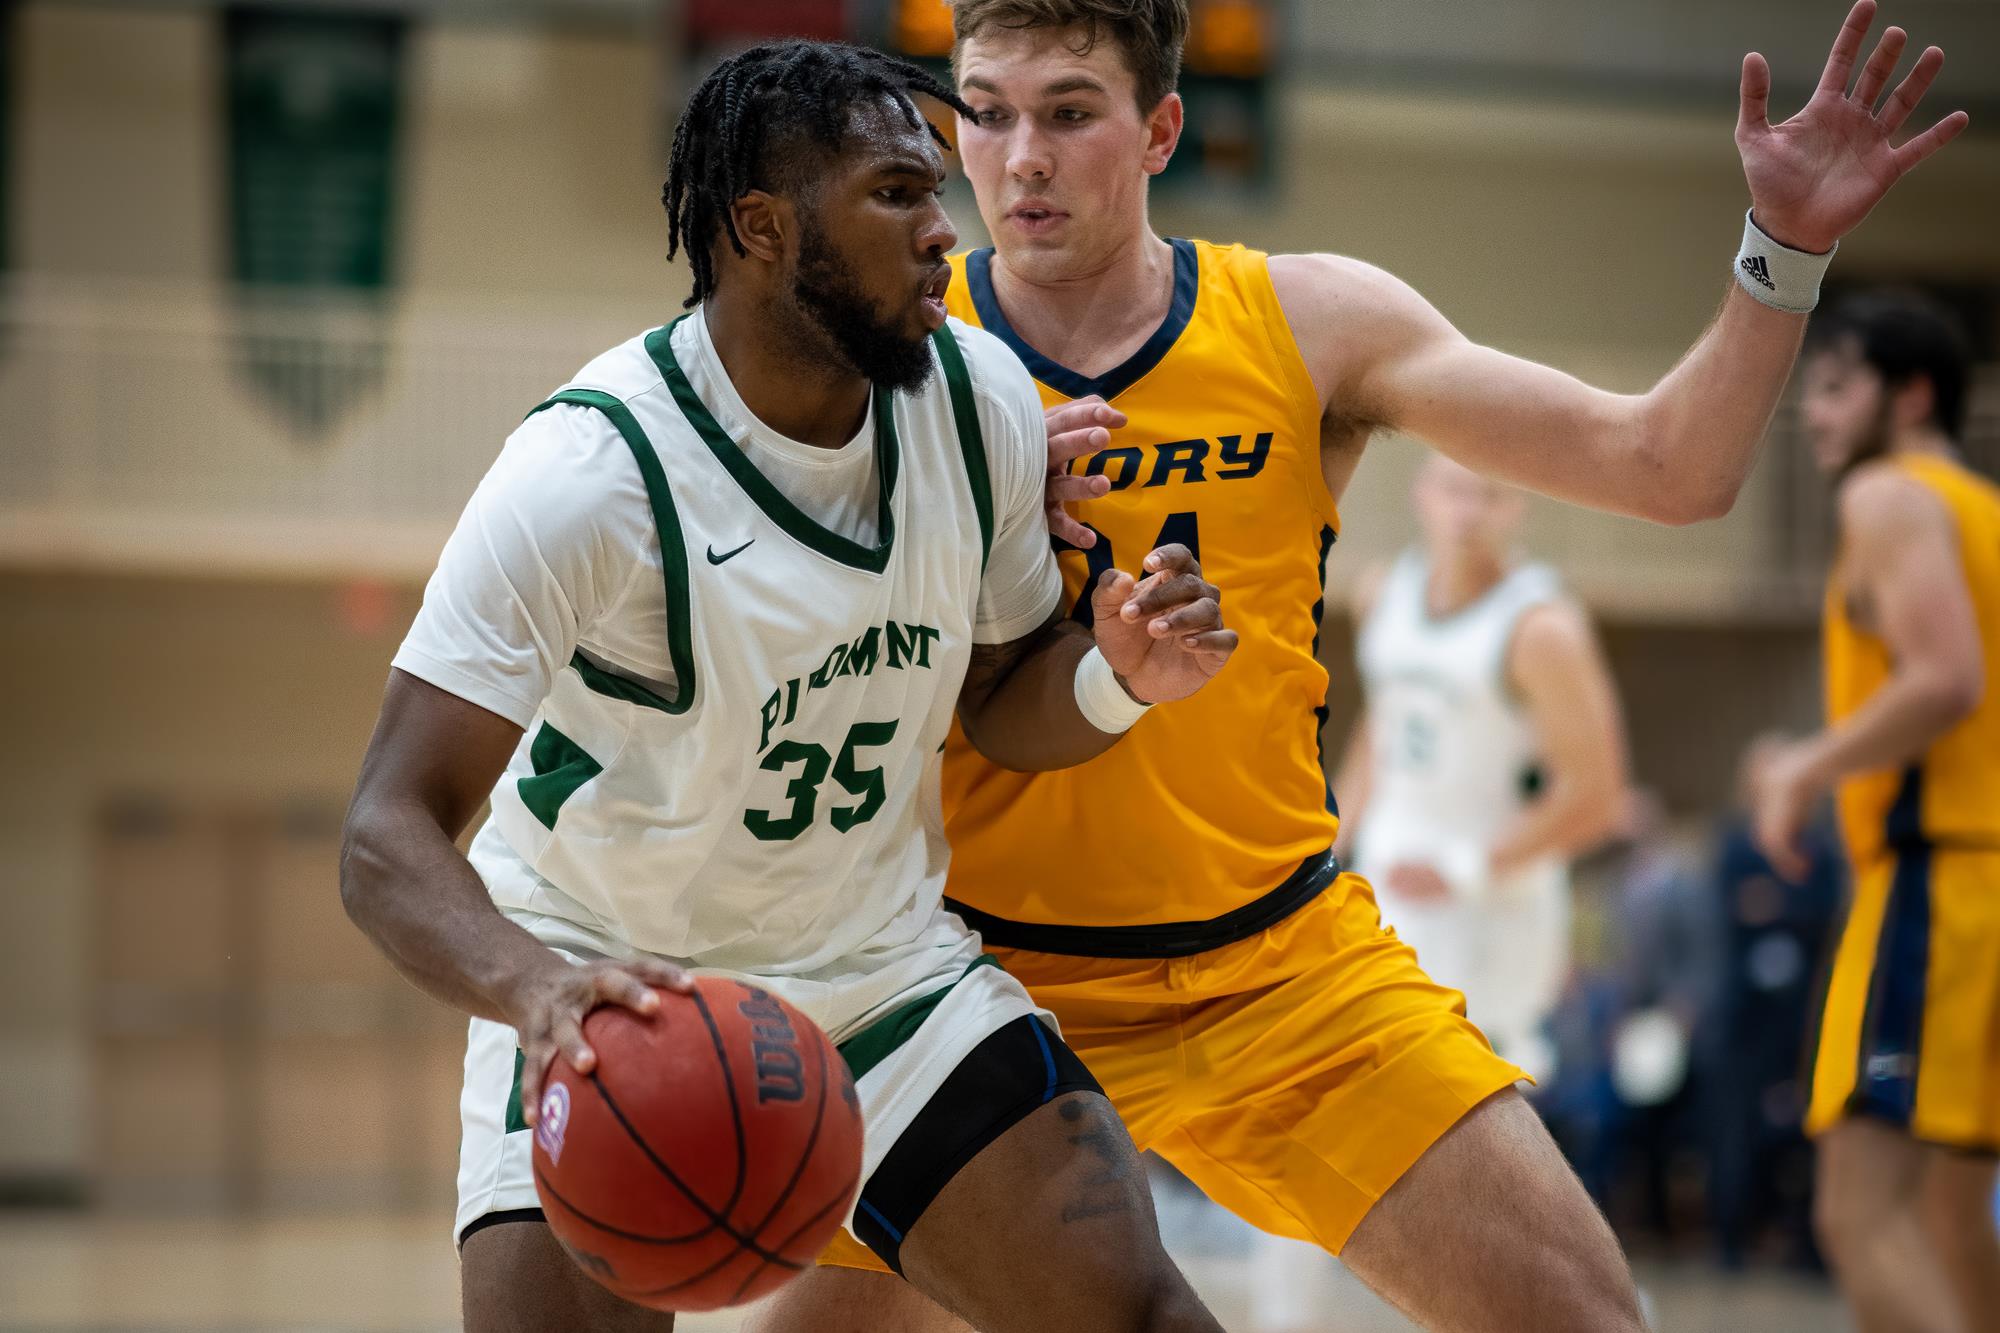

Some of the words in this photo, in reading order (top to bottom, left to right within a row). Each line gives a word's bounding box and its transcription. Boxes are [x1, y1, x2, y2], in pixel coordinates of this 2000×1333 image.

[1741, 260, 1775, 290] adidas
[1067, 432, 1274, 492] ORY
[743, 718, 899, 840] 35
